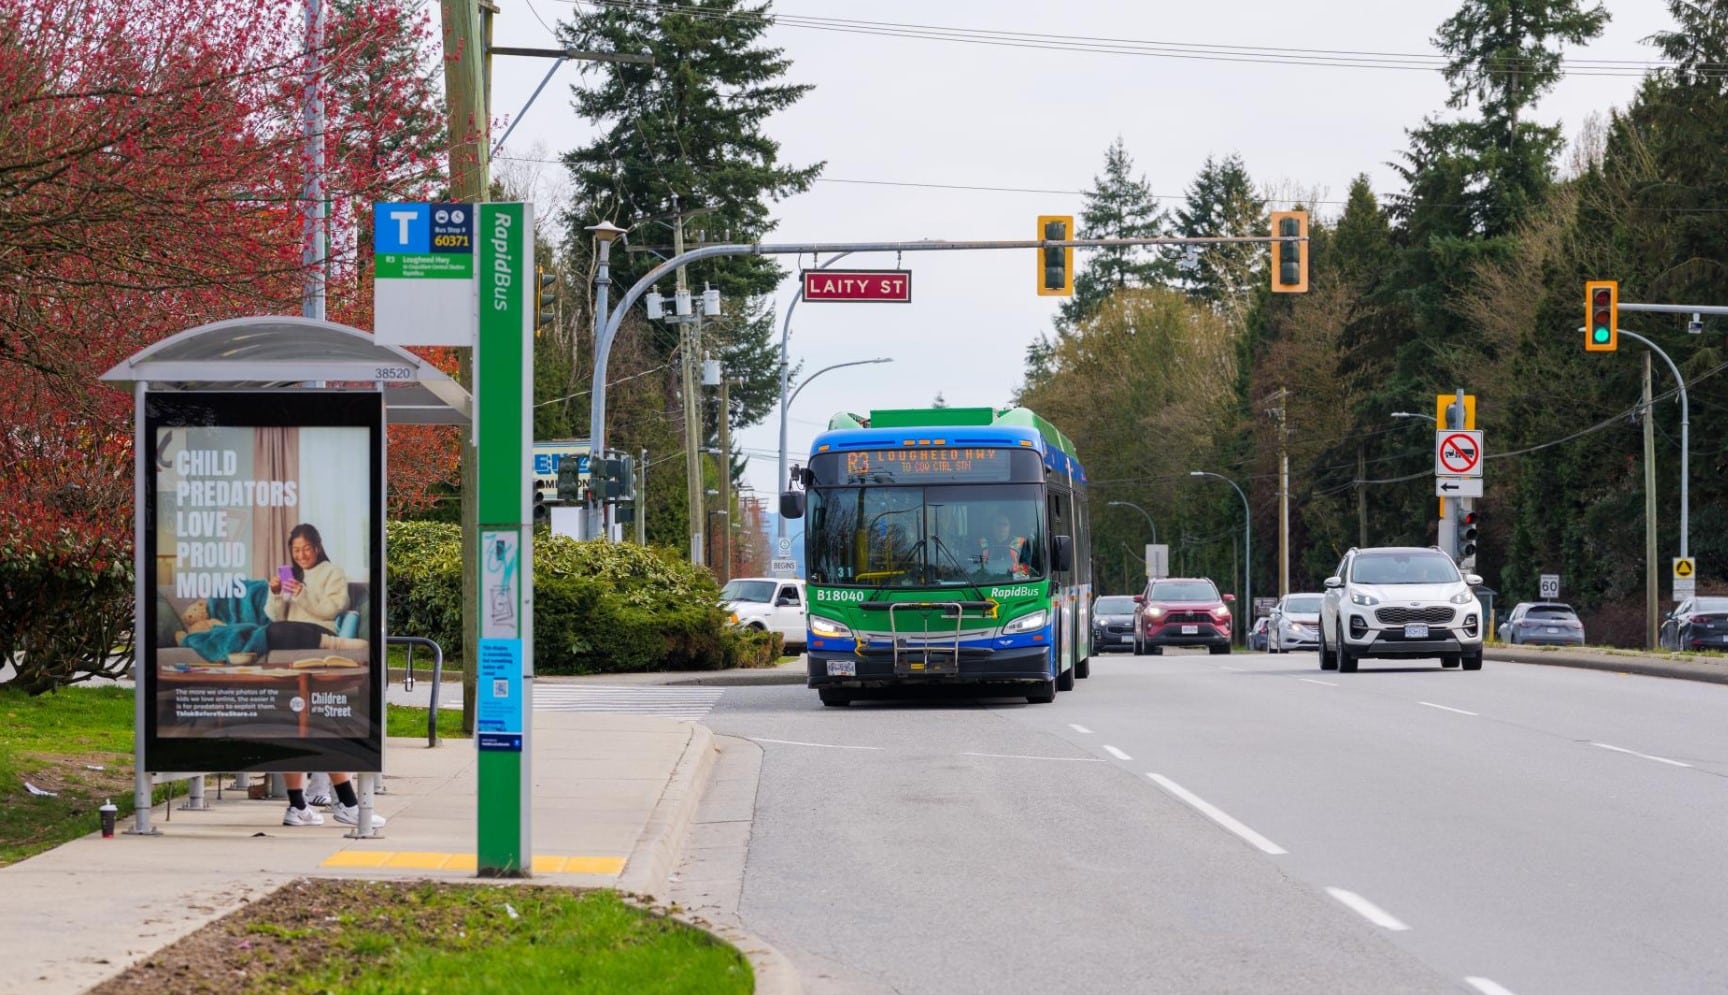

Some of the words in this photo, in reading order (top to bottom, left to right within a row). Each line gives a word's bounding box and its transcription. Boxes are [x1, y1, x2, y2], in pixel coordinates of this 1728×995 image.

[390, 211, 418, 245] T
[447, 226, 460, 234] Stop
[434, 235, 469, 247] 60371
[491, 212, 512, 311] RapidBus
[810, 279, 869, 294] LAITY
[880, 280, 903, 294] ST
[375, 367, 410, 379] 38520
[176, 450, 237, 476] CHILD
[847, 452, 870, 476] R3
[877, 450, 958, 462] LOUGHEED
[965, 449, 996, 460] HWY
[176, 481, 298, 507] PREDATORS
[176, 512, 227, 537] LOVE
[176, 542, 246, 568] PROUD
[176, 573, 247, 599] MOMS
[991, 586, 1039, 599] RapidBus
[1542, 580, 1558, 592] 60
[817, 590, 864, 601] B18040
[311, 692, 347, 704] Children
[324, 705, 352, 717] Street
